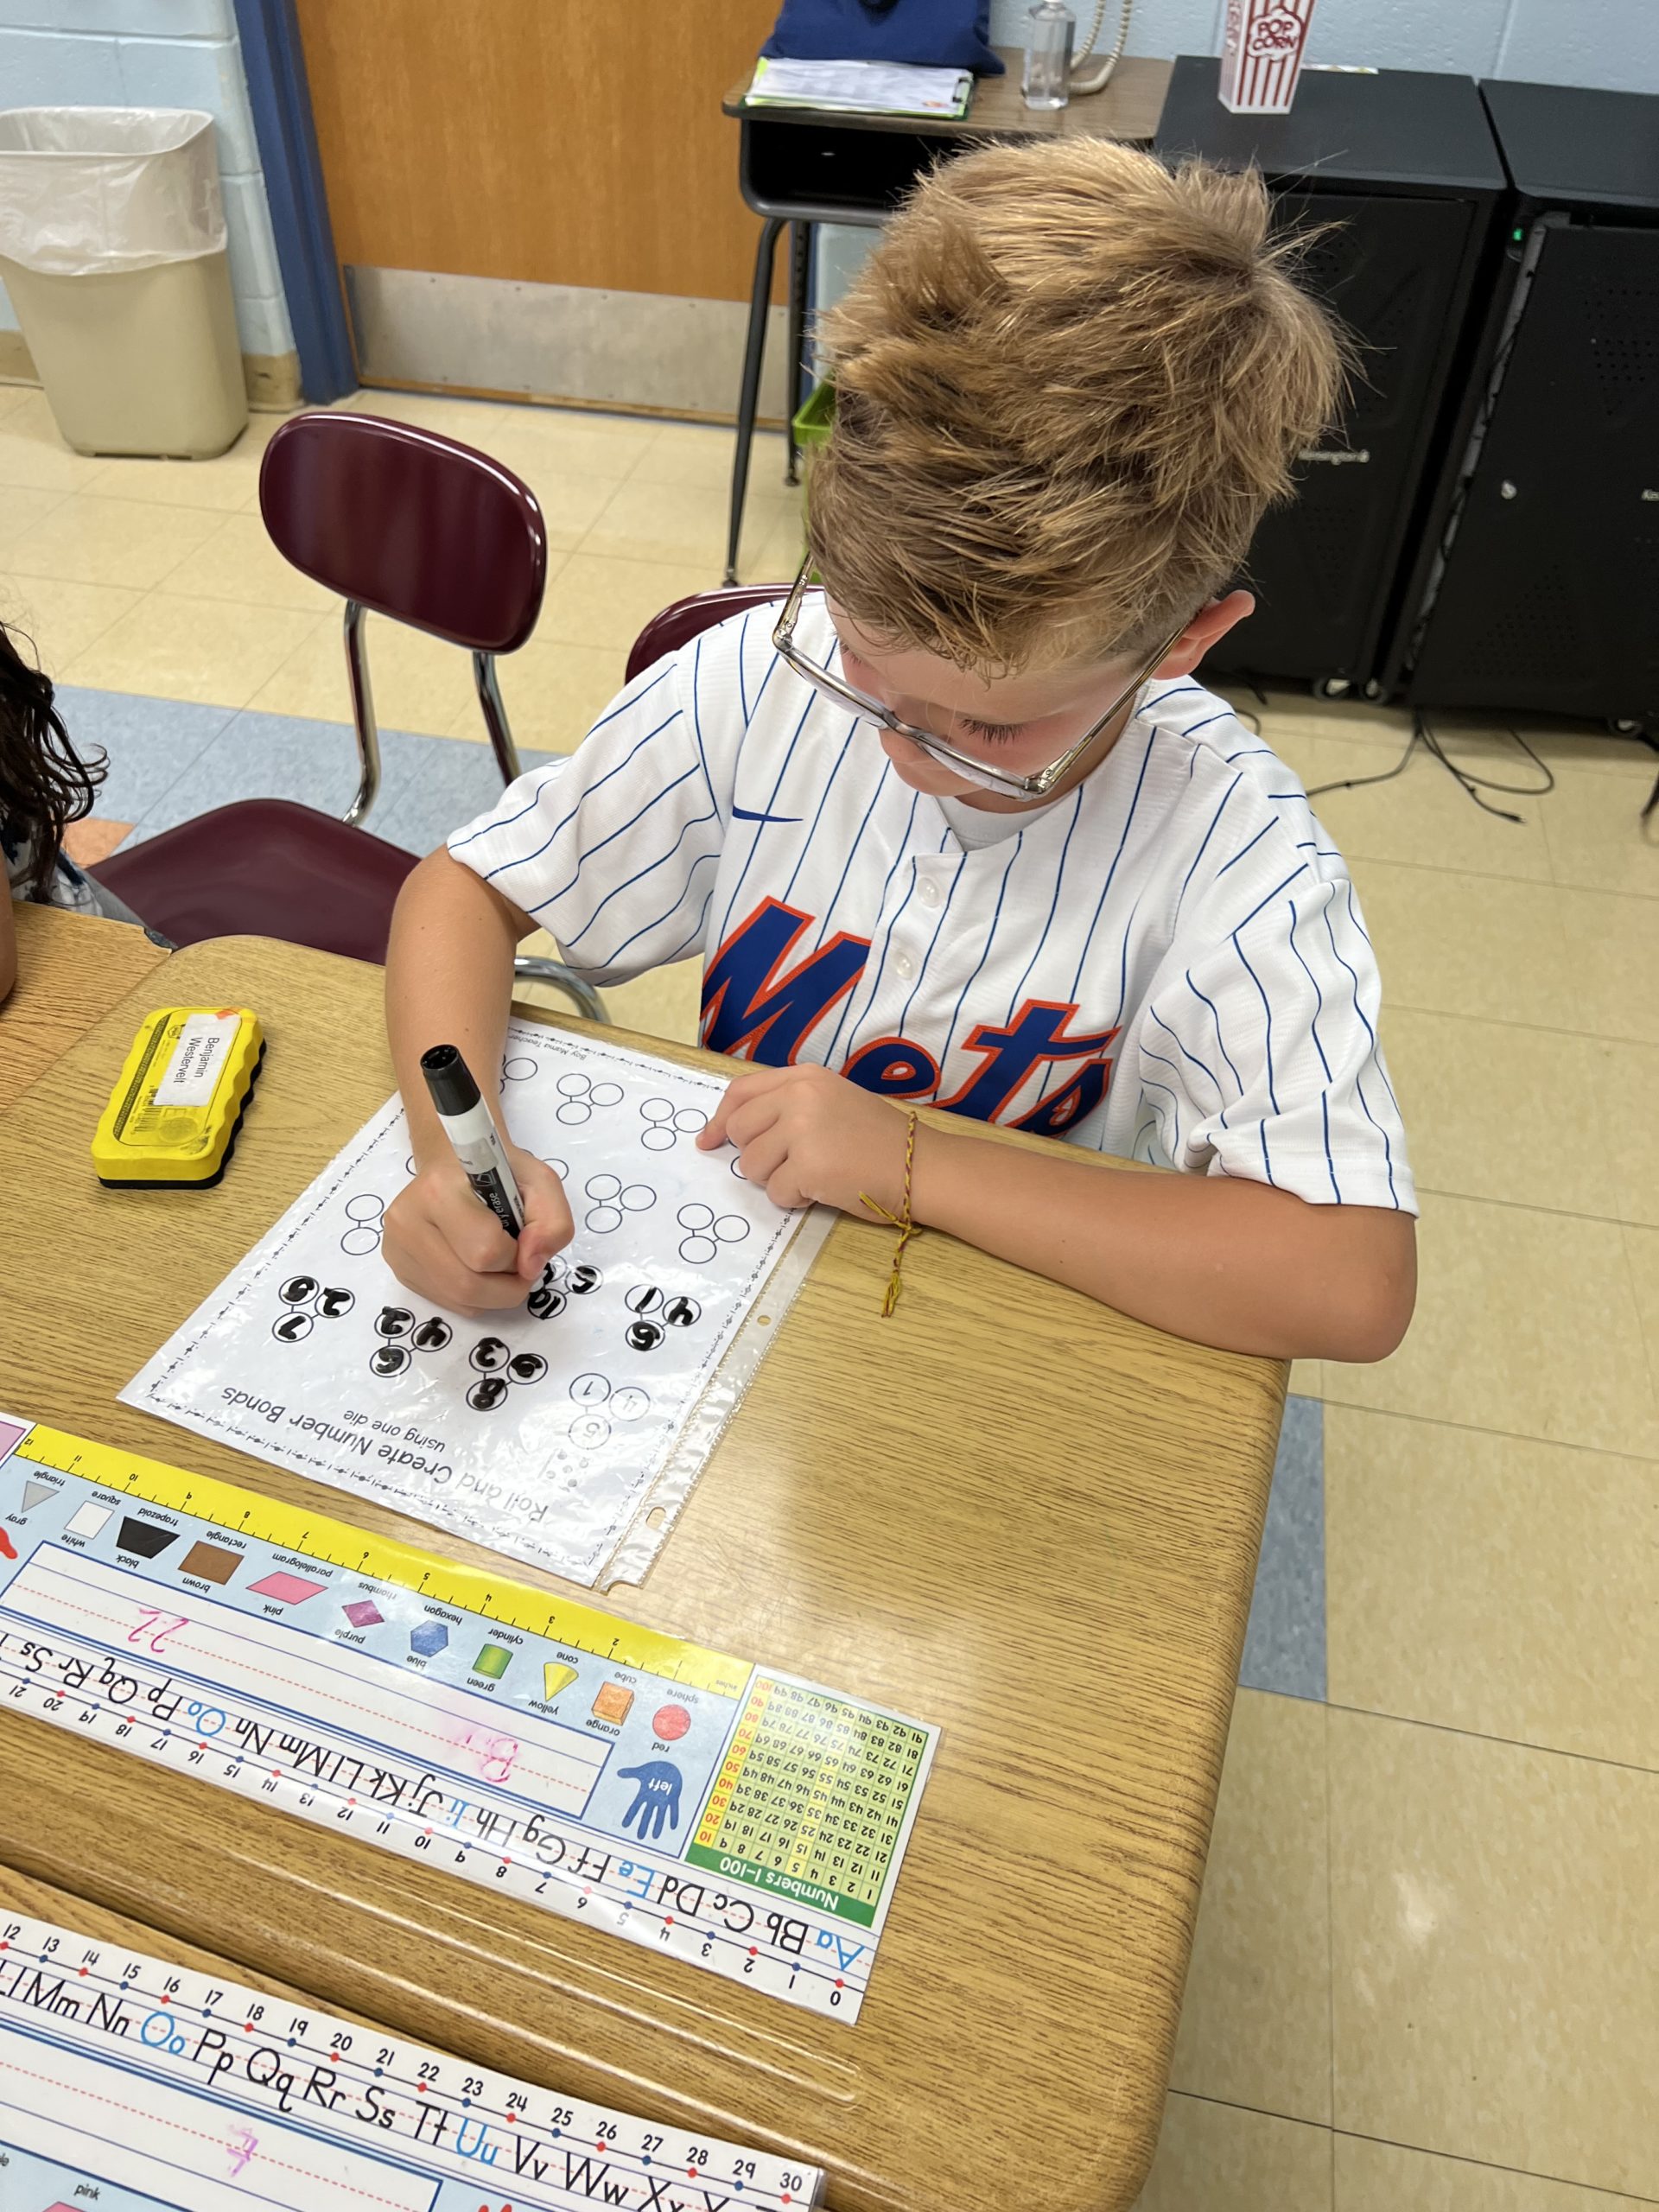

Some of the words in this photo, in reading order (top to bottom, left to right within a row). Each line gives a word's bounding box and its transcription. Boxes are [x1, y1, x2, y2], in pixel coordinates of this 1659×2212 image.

[1258, 19, 1294, 35] POP
[1253, 35, 1298, 50] CORN
[699, 896, 1122, 1137] Mets
[174, 1037, 203, 1083] Westervelt
[194, 1037, 219, 1077] Benjamin
[582, 1382, 594, 1395] 1
[221, 1388, 285, 1423] Bonds
[343, 1410, 368, 1426] die
[289, 1414, 372, 1455] Number
[372, 1421, 401, 1436] one
[24, 1438, 34, 1447] 12
[404, 1427, 445, 1453] using
[377, 1444, 453, 1484] Create
[33, 1470, 66, 1487] triangle
[128, 1474, 138, 1483] 10
[454, 1472, 501, 1503] and
[92, 1491, 121, 1506] square
[502, 1491, 548, 1522] Roll
[4, 1514, 28, 1527] gray
[137, 1507, 179, 1527] trapezoid
[61, 1534, 86, 1548] white
[207, 1530, 247, 1550] rectangle
[116, 1554, 140, 1569] black
[272, 1553, 333, 1579] parallelogram
[424, 1572, 430, 1580] 5
[181, 1577, 211, 1592] brown
[358, 1581, 397, 1600] rhombus
[485, 1593, 492, 1602] 4
[263, 1604, 283, 1617] pink
[423, 1605, 462, 1624] hexagon
[549, 1615, 555, 1624] 3
[128, 1609, 188, 1653] 22
[334, 1628, 365, 1644] purple
[488, 1628, 524, 1646] cylinder
[20, 1642, 53, 1671] Ss
[406, 1656, 427, 1669] blue
[556, 1652, 578, 1664] cone
[59, 1657, 94, 1688] Rr
[99, 1657, 138, 1703] Qq
[614, 1672, 637, 1686] cube
[10, 1686, 27, 1697] 21
[467, 1678, 496, 1693] green
[44, 1697, 63, 1711] 20
[148, 1678, 182, 1720] Pp
[666, 1688, 699, 1704] sphere
[529, 1700, 559, 1716] yellow
[79, 1711, 96, 1724] 19
[188, 1701, 226, 1737] Oo
[116, 1724, 131, 1737] 18
[235, 1718, 274, 1754] Nn
[586, 1719, 620, 1737] orange
[151, 1738, 167, 1750] 17
[652, 1742, 670, 1753] red
[188, 1751, 204, 1764] 16
[279, 1734, 331, 1777] Mm
[224, 1764, 240, 1777] 15
[328, 1756, 365, 1789] Ll
[262, 1778, 278, 1792] 14
[371, 1768, 407, 1806] Kk
[648, 1777, 672, 1796] left
[300, 1792, 315, 1806] 13
[408, 1774, 442, 1818] Jj
[337, 1807, 353, 1821] 12
[446, 1799, 469, 1829] Ii
[377, 1823, 390, 1834] 11
[476, 1808, 517, 1847] Hh
[415, 1836, 430, 1849] 10
[523, 1815, 565, 1865] Gg
[700, 1832, 711, 1844] 10
[455, 1851, 465, 1863] 9
[569, 1847, 611, 1883] Ff
[496, 1866, 507, 1878] 8
[619, 1861, 655, 1899] Ee
[536, 1882, 547, 1894] 7
[765, 1872, 839, 1910] Numbers
[847, 1882, 855, 1892] 2
[868, 1890, 872, 1899] 1
[578, 1897, 588, 1909] 6
[657, 1876, 705, 1916] Dd
[617, 1912, 629, 1925] 5
[714, 1894, 754, 1933] Cc
[660, 1928, 670, 1942] 4
[767, 1912, 809, 1955] Bb
[702, 1943, 712, 1956] 3
[817, 1930, 865, 1971] Aa
[744, 1958, 754, 1973] 2
[789, 1975, 795, 1989] 1
[830, 1992, 841, 2005] 0
[3, 1924, 21, 1940] 12
[43, 1936, 60, 1952] 13
[82, 1950, 99, 1965] 14
[123, 1963, 141, 1979] 15
[163, 1977, 181, 1993] 16
[205, 1990, 223, 2005] 17
[245, 2005, 264, 2020] 18
[290, 2018, 308, 2036] 19
[330, 2033, 353, 2050] 20
[376, 2049, 394, 2066] 21
[417, 2063, 440, 2082] 22
[461, 2077, 484, 2096] 23
[506, 2092, 528, 2112] 24
[551, 2107, 574, 2126] 25
[595, 2122, 618, 2140] 26
[641, 2135, 664, 2152] 27
[686, 2147, 709, 2165] 28
[733, 2160, 756, 2178] 29
[780, 2172, 803, 2191] 30
[22, 1972, 79, 2018] Mm
[86, 1993, 130, 2037] Nn
[141, 2012, 185, 2055] Oo
[193, 2029, 233, 2084] Pp
[247, 2048, 295, 2113] Qq
[303, 2066, 346, 2109] Rr
[356, 2087, 395, 2128] Ss
[415, 2102, 447, 2145] Tt
[455, 2118, 499, 2165] Uu
[516, 2135, 548, 2180] Vv
[566, 2152, 628, 2205] Ww
[75, 2183, 100, 2200] pink
